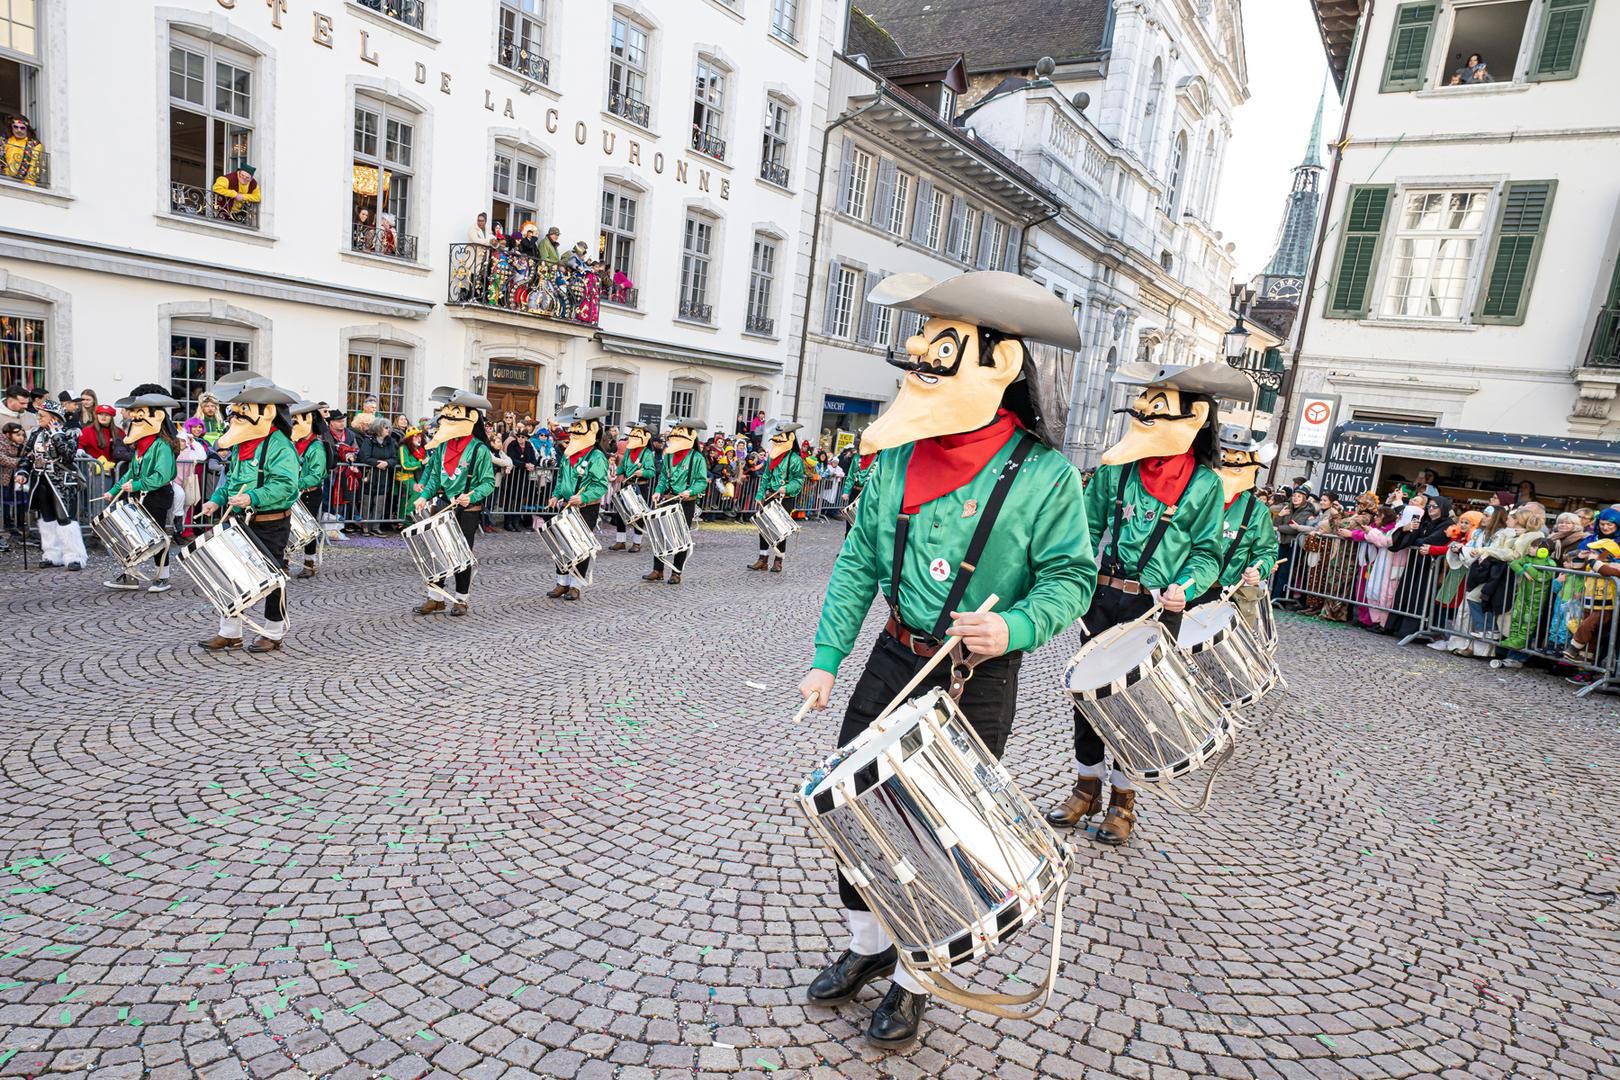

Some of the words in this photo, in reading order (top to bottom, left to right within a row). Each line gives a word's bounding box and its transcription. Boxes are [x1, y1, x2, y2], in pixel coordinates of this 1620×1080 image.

[415, 61, 453, 95] DE
[484, 89, 515, 119] LA
[545, 107, 732, 200] COURONNE
[492, 367, 527, 381] COURONNE
[1330, 442, 1377, 464] MIETEN
[1323, 472, 1369, 495] EVENTS
